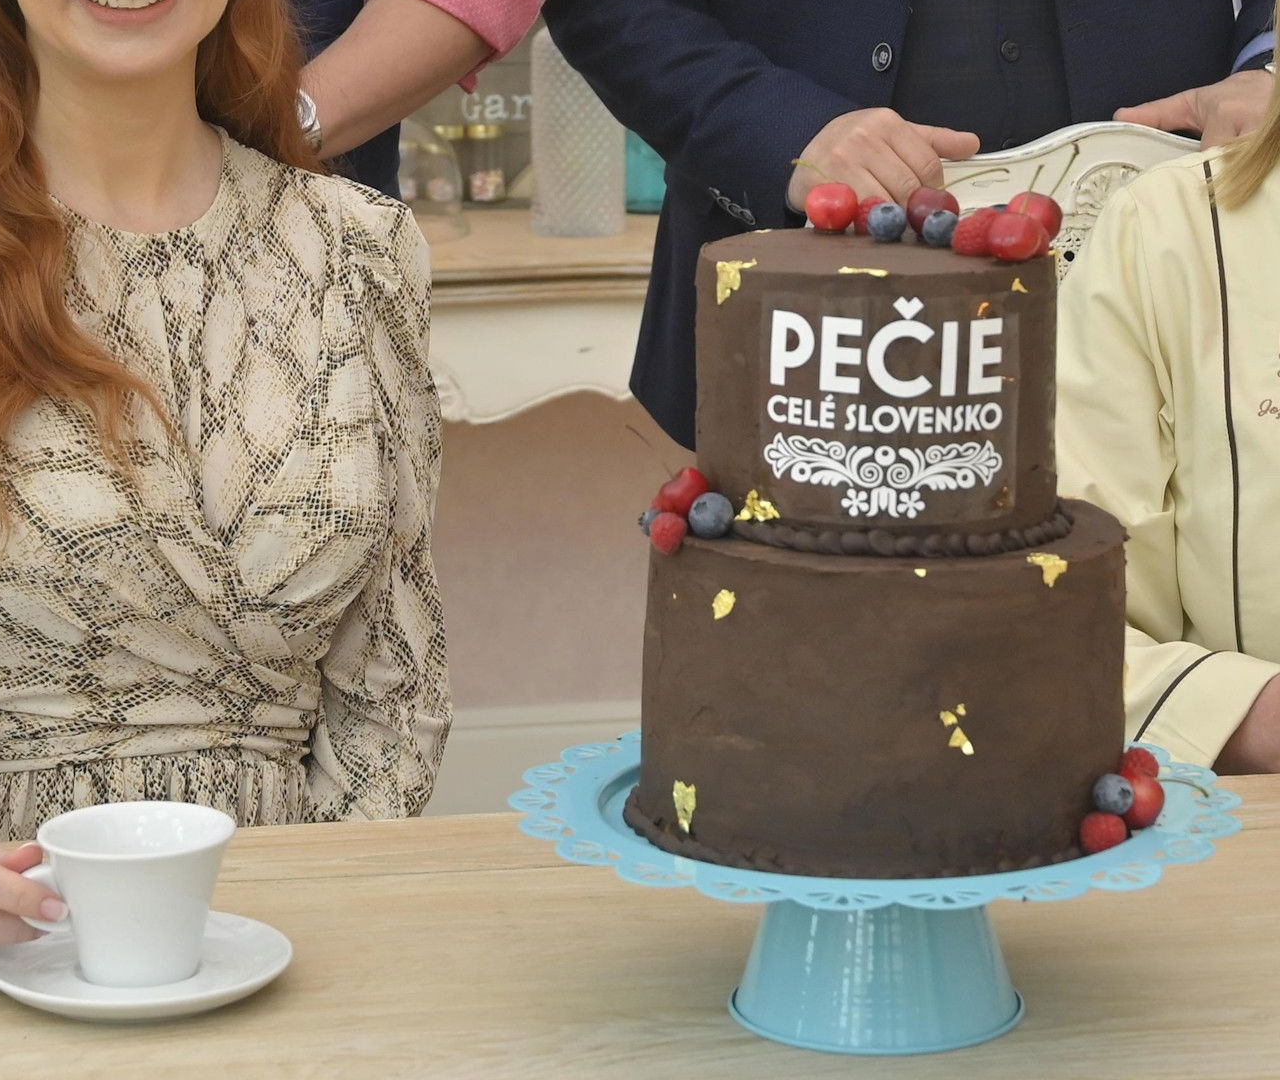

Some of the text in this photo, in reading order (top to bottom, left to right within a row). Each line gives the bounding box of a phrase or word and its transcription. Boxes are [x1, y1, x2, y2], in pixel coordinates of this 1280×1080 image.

[461, 92, 532, 121] Gar
[769, 296, 1004, 398] PEČIE
[766, 394, 1003, 434] CELÉ SLOVENSKO
